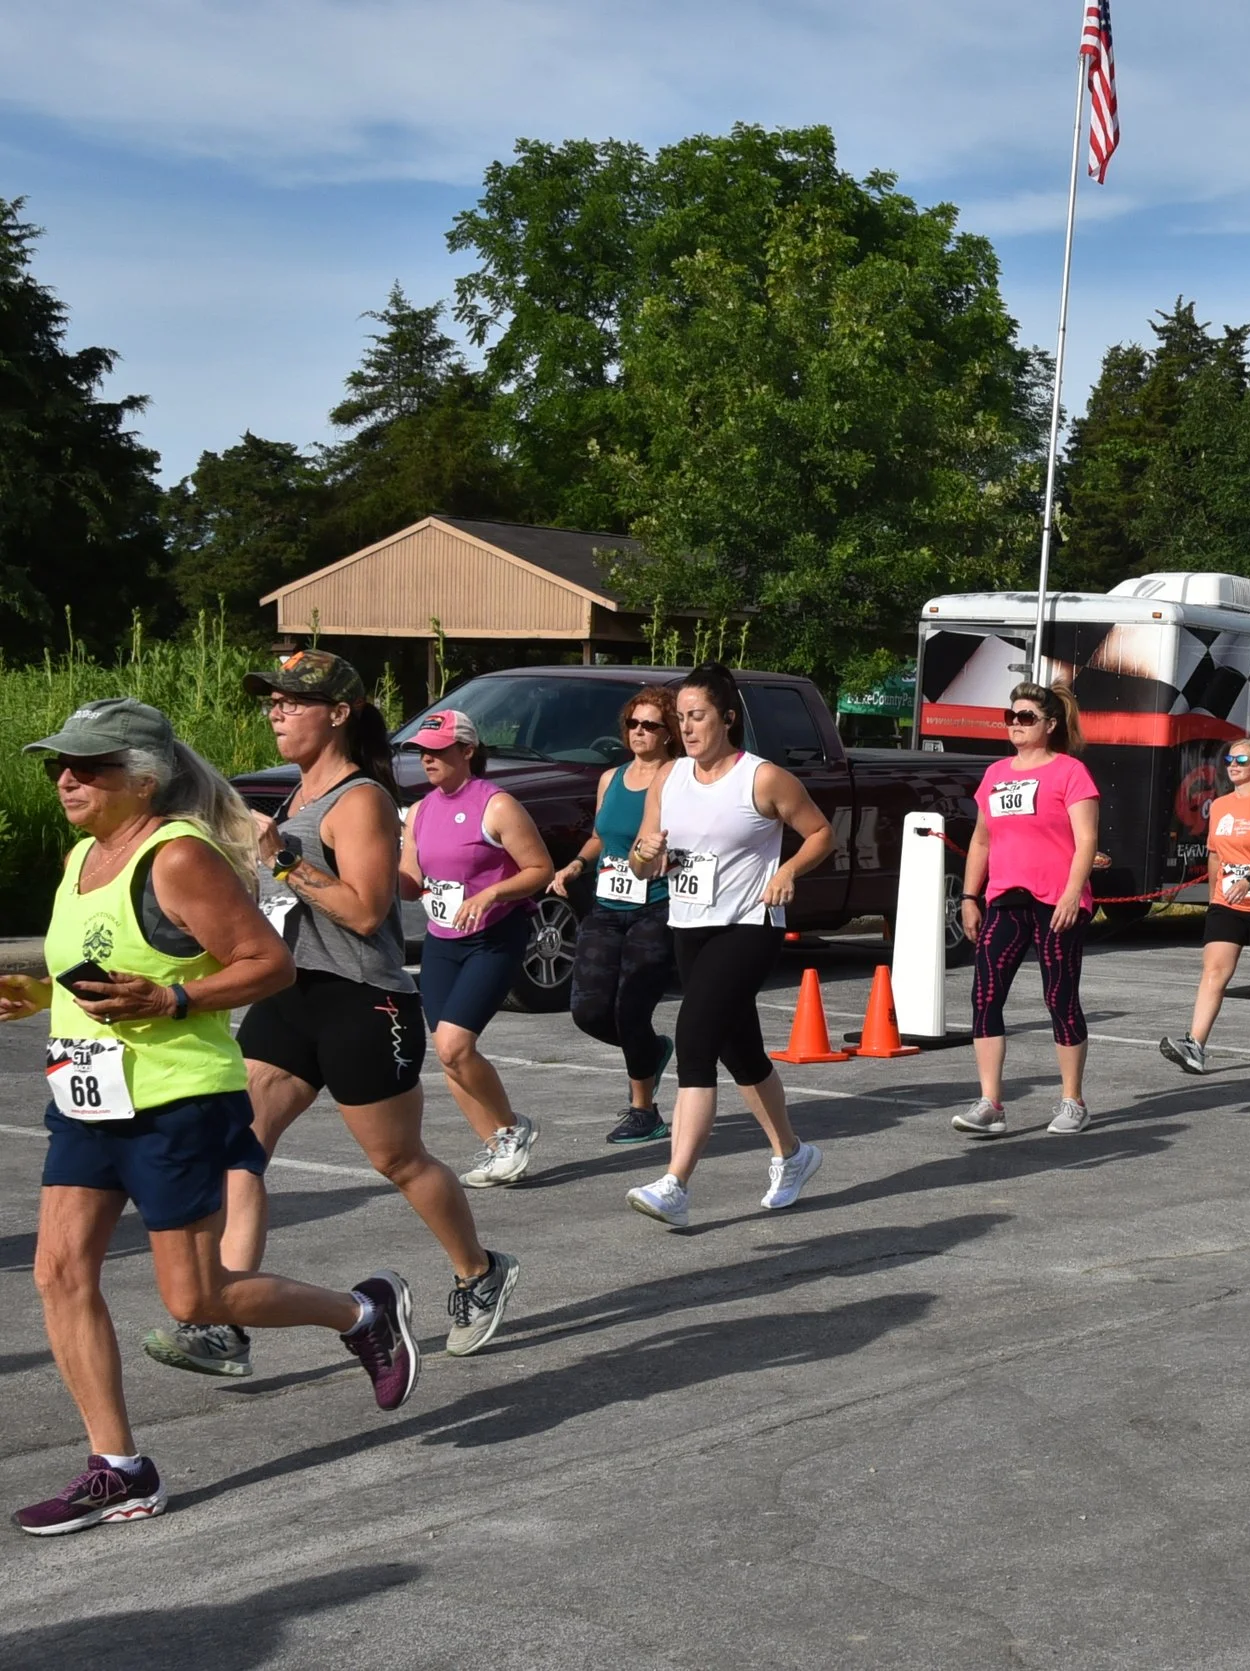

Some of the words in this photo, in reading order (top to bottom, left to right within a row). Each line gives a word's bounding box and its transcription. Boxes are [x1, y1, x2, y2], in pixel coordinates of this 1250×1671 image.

[1000, 793, 1022, 810] 130
[610, 876, 633, 895] 137
[674, 874, 698, 895] 126
[431, 900, 447, 920] 62
[374, 996, 413, 1080] pink
[70, 1075, 102, 1107] 68
